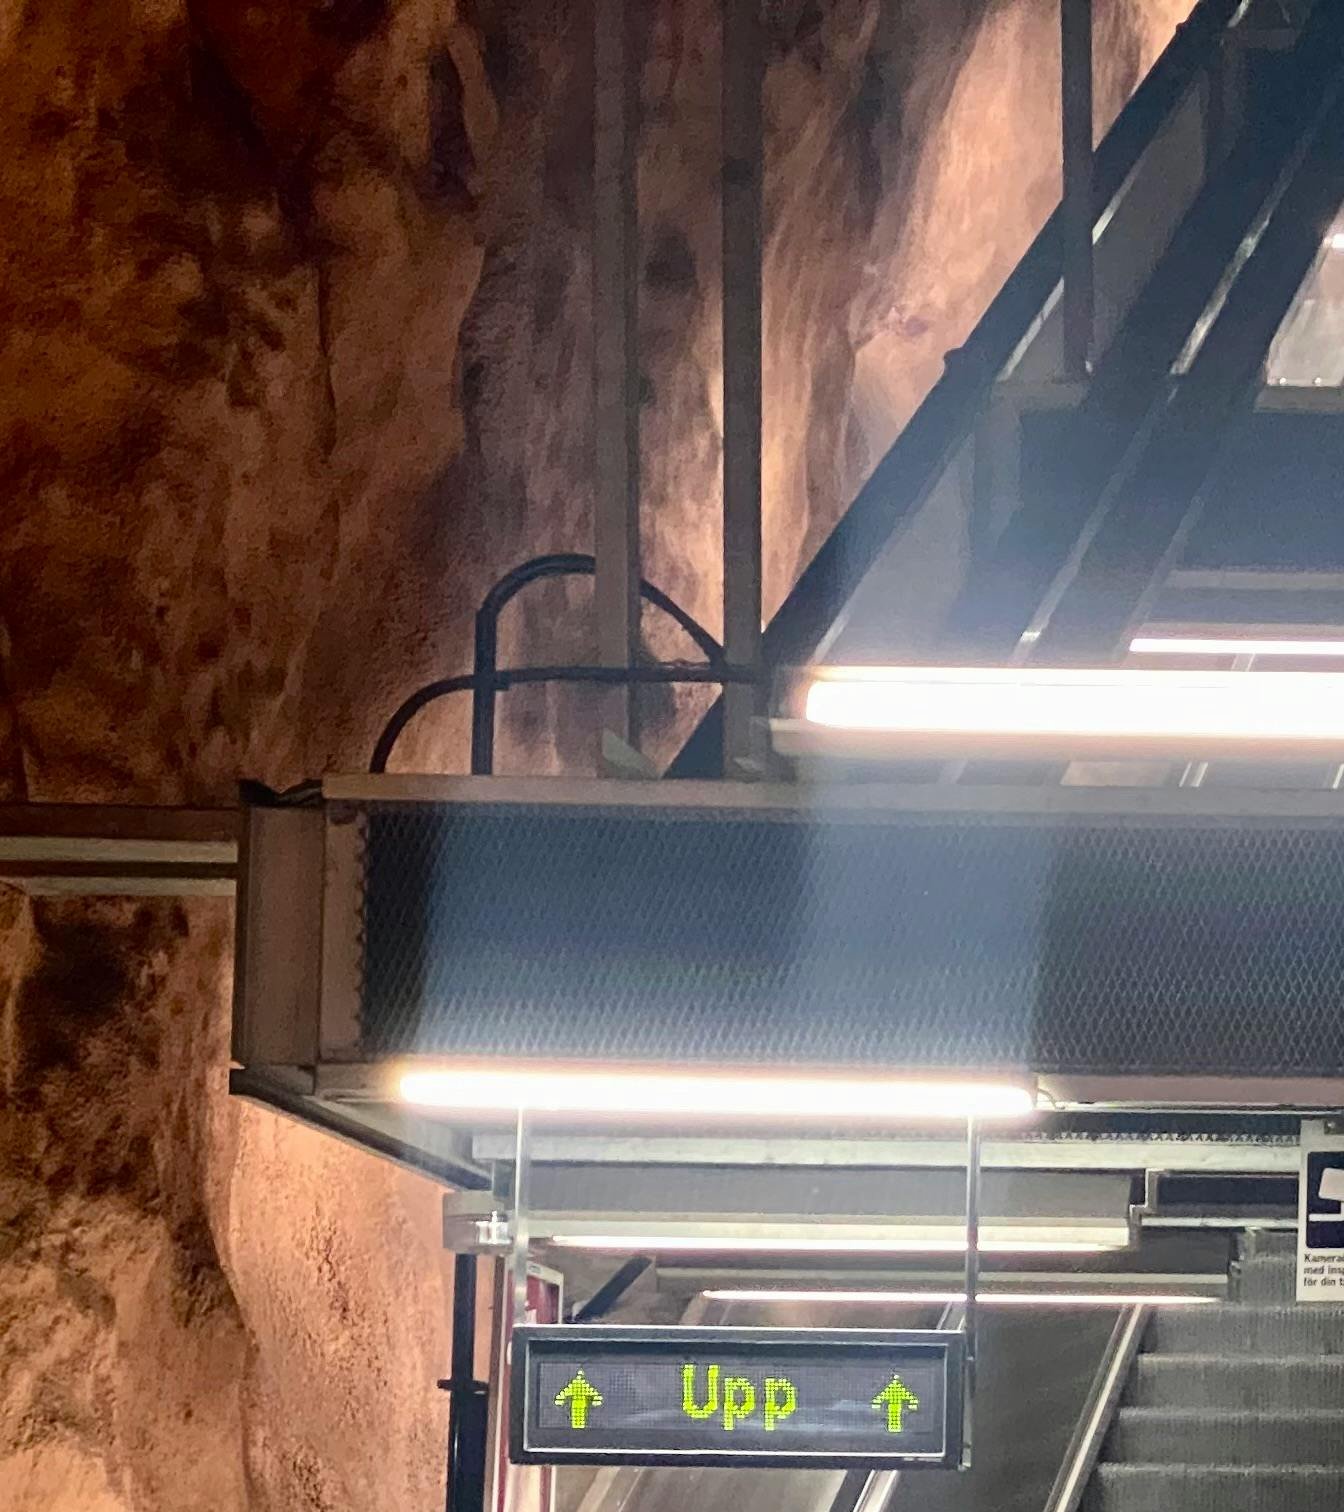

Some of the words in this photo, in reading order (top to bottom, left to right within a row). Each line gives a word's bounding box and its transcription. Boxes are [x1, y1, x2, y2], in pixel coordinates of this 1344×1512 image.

[1303, 1265, 1324, 1275] med
[1303, 1277, 1316, 1287] för
[1321, 1277, 1336, 1287] din
[682, 1363, 798, 1431] Upp
